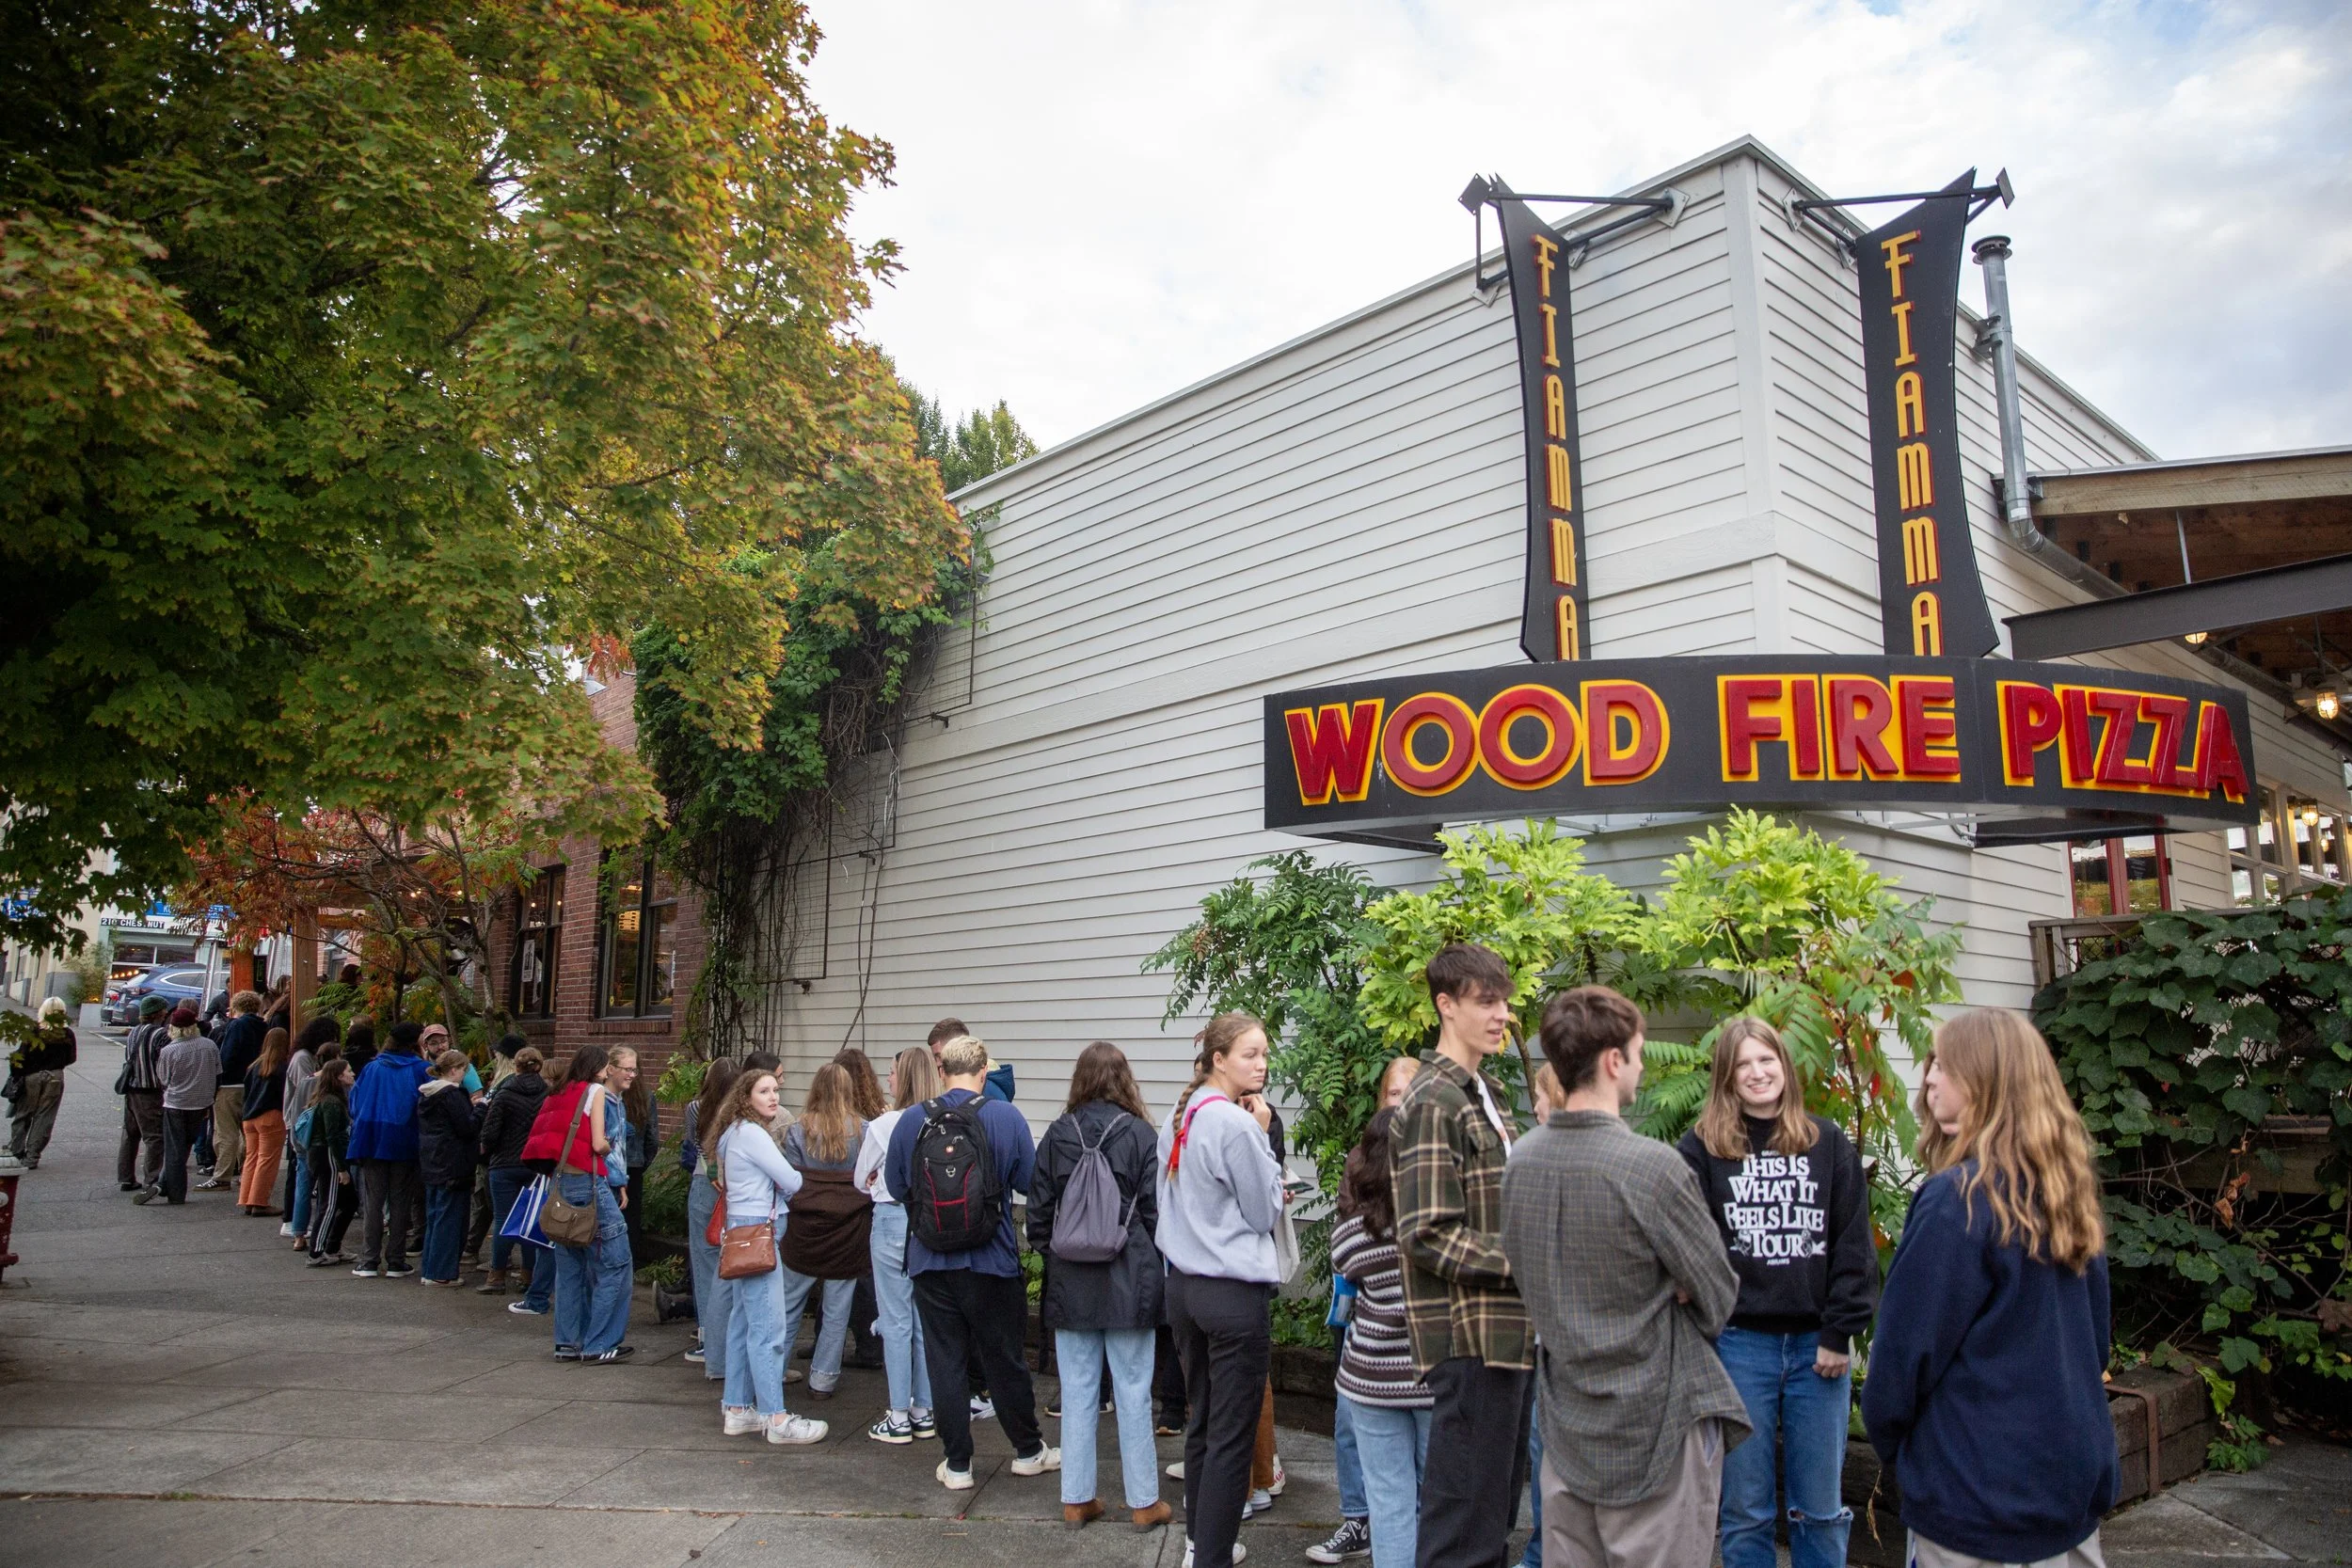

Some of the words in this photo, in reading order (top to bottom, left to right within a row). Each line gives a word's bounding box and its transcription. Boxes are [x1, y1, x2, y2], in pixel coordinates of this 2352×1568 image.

[1530, 233, 1580, 662] FIAMMA
[1882, 230, 1942, 657] FIAMMA
[1283, 679, 1671, 806] WOOD
[1716, 673, 1961, 784] FIRE
[1995, 680, 2251, 804] PIZZA
[1741, 1154, 1787, 1176] THIS
[1788, 1155, 1810, 1177] IS
[1728, 1176, 1796, 1203] WHAT
[1796, 1177, 1819, 1204] IT
[1724, 1202, 1781, 1230] FEELS
[1782, 1202, 1825, 1232] LIKE
[1751, 1229, 1806, 1258] TOUR
